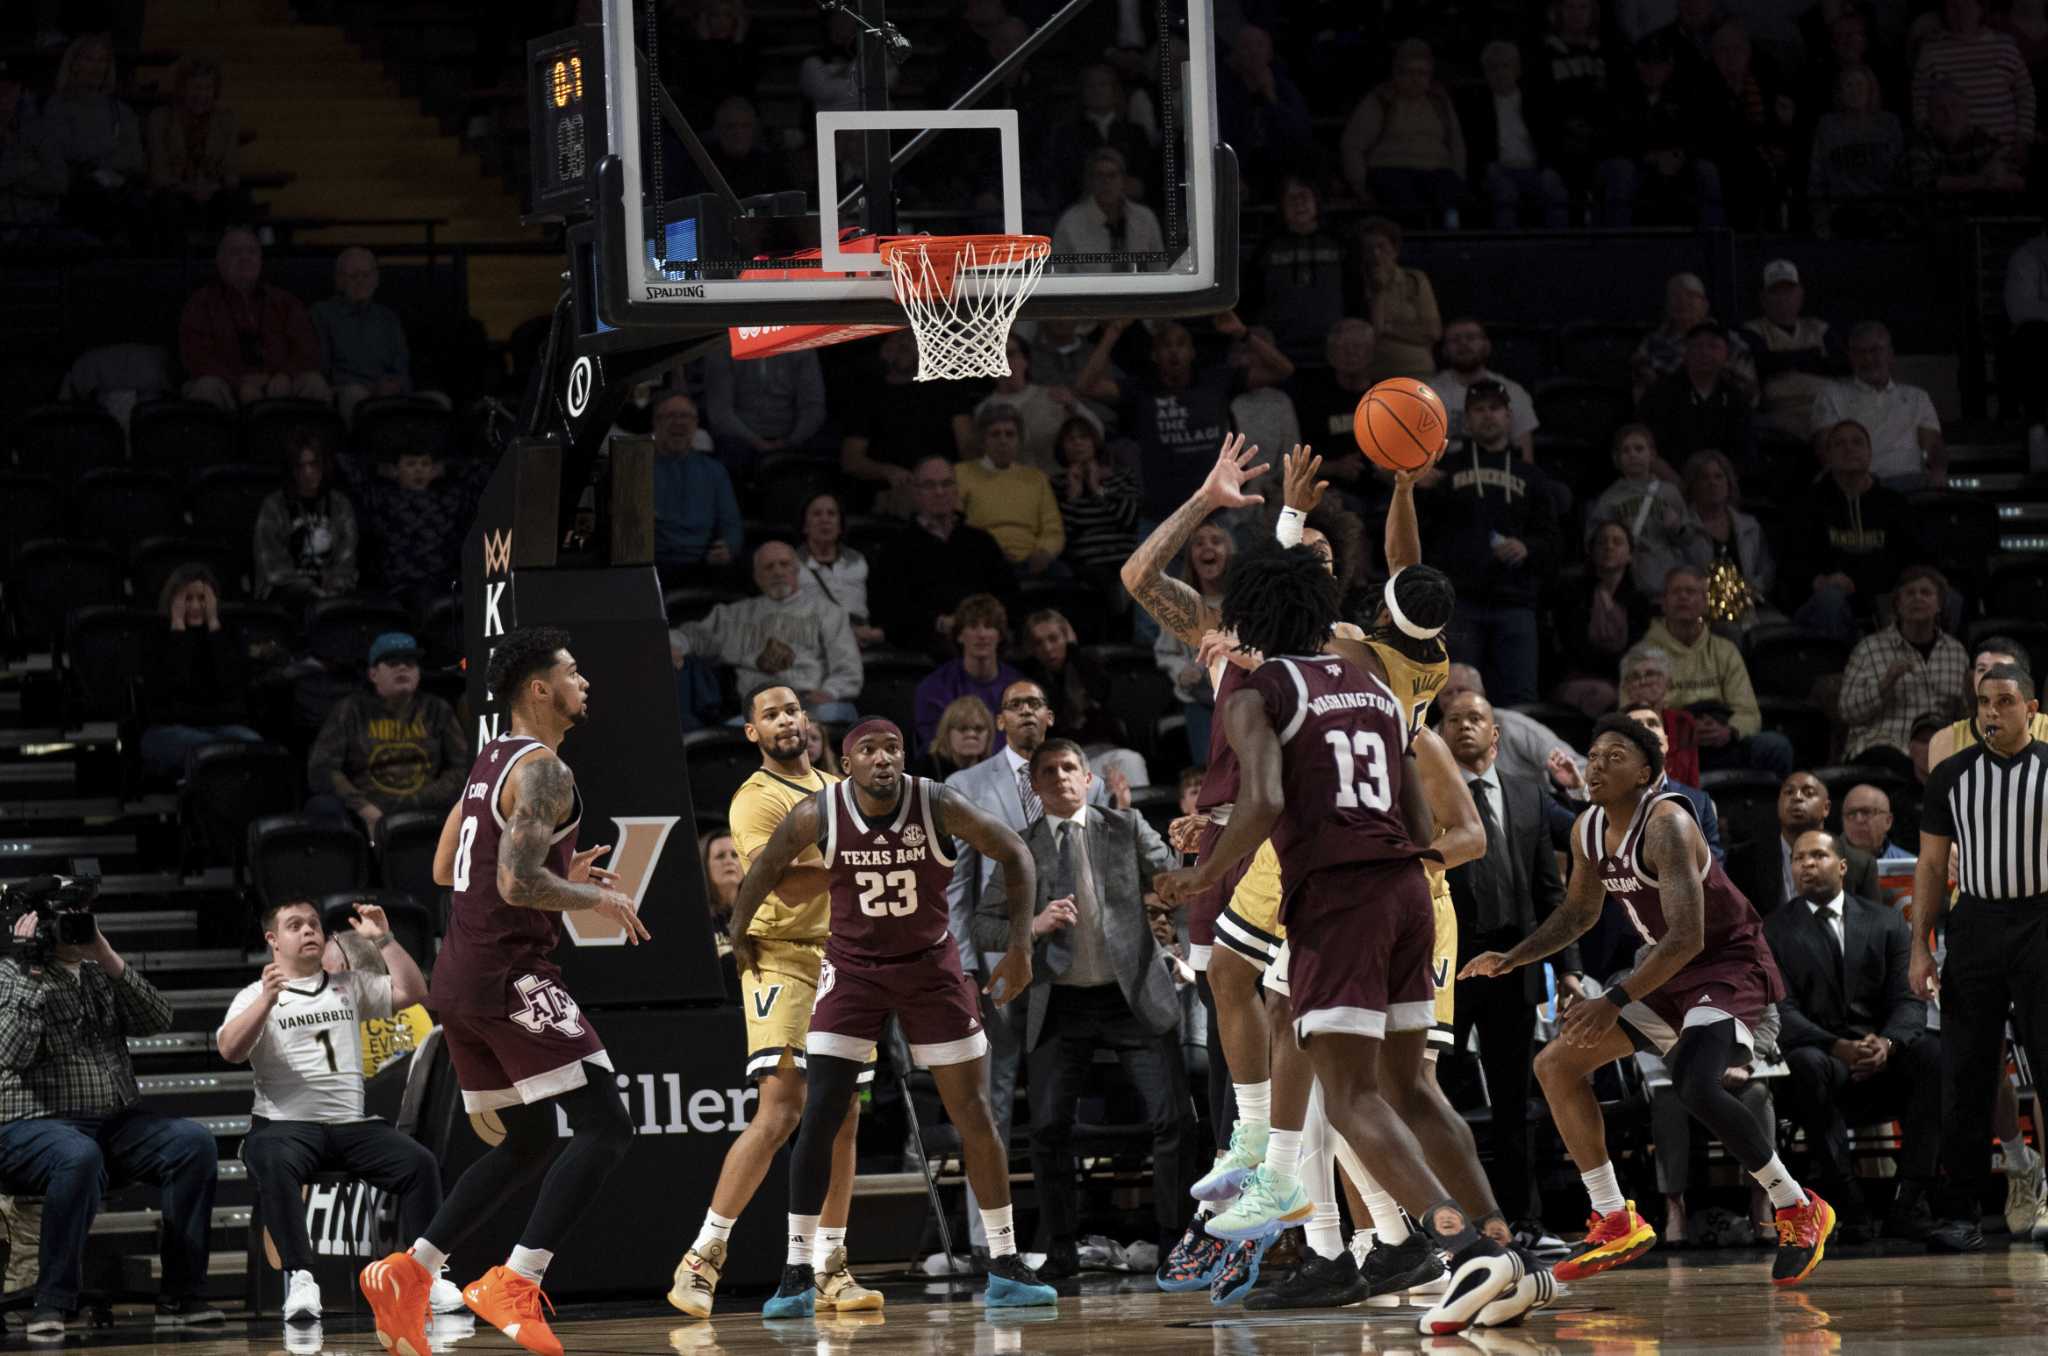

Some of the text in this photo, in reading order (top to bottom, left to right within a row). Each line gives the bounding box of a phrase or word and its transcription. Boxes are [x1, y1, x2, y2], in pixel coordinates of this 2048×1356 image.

[646, 285, 704, 300] SPALDING
[1308, 692, 1396, 718] WASHINGTON
[1324, 729, 1393, 813] 13
[453, 815, 479, 893] 0
[840, 847, 926, 866] TEXAS A&M
[854, 869, 919, 918] 23
[753, 985, 782, 1018] V
[278, 1009, 354, 1030] VANDERBILT
[315, 1029, 339, 1073] 1
